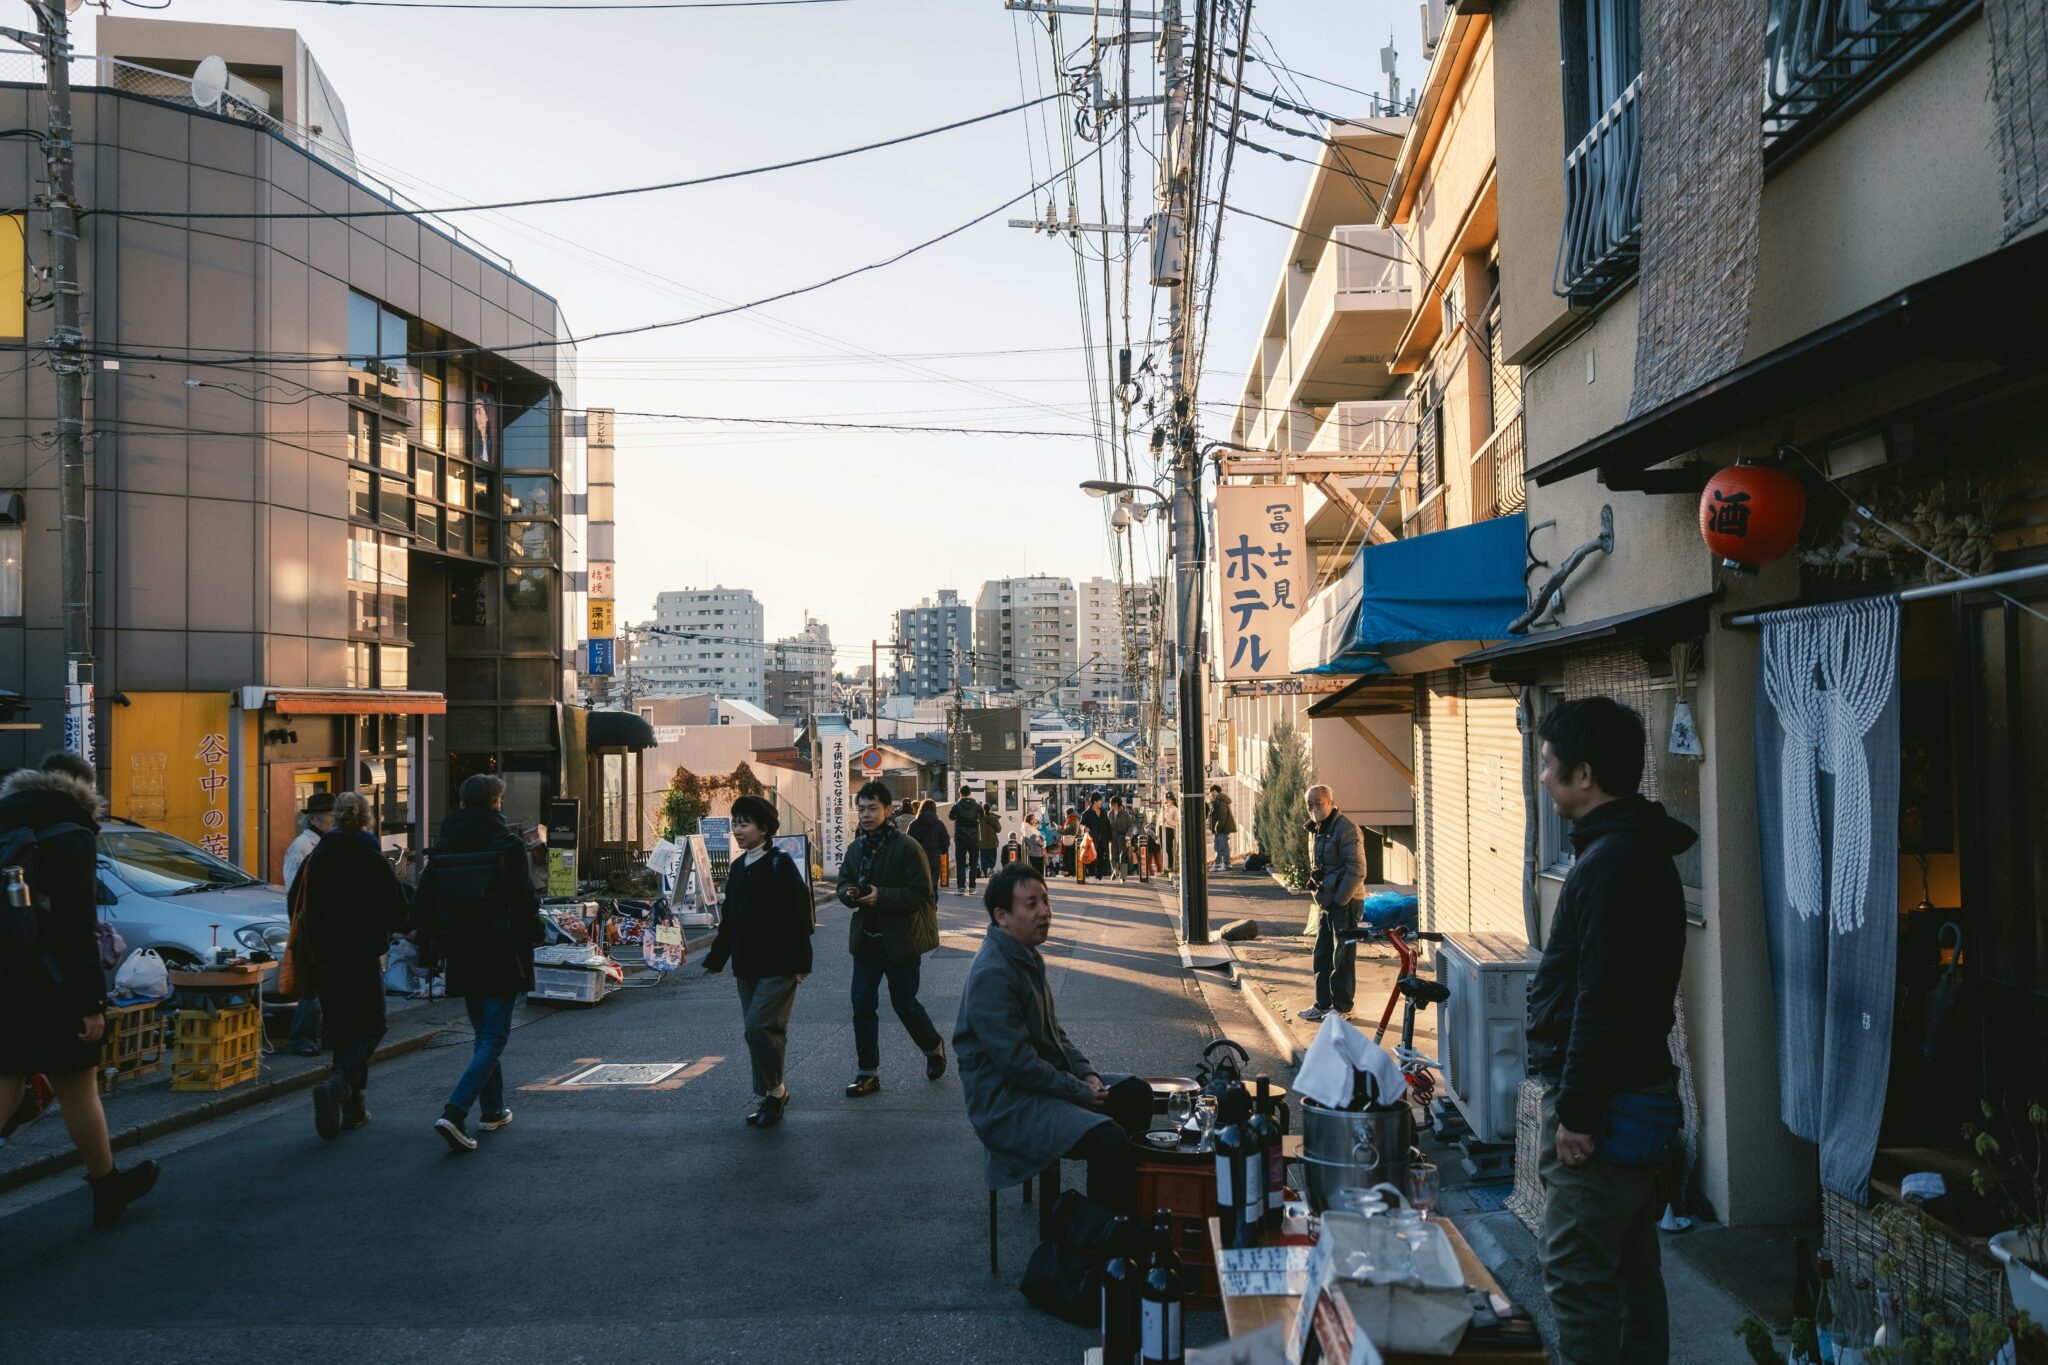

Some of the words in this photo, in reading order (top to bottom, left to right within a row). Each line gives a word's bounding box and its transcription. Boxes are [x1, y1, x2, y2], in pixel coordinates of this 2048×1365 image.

[1708, 489, 1751, 538] 酒
[1225, 534, 1271, 673] ホテル
[73, 716, 81, 750] UNCLE
